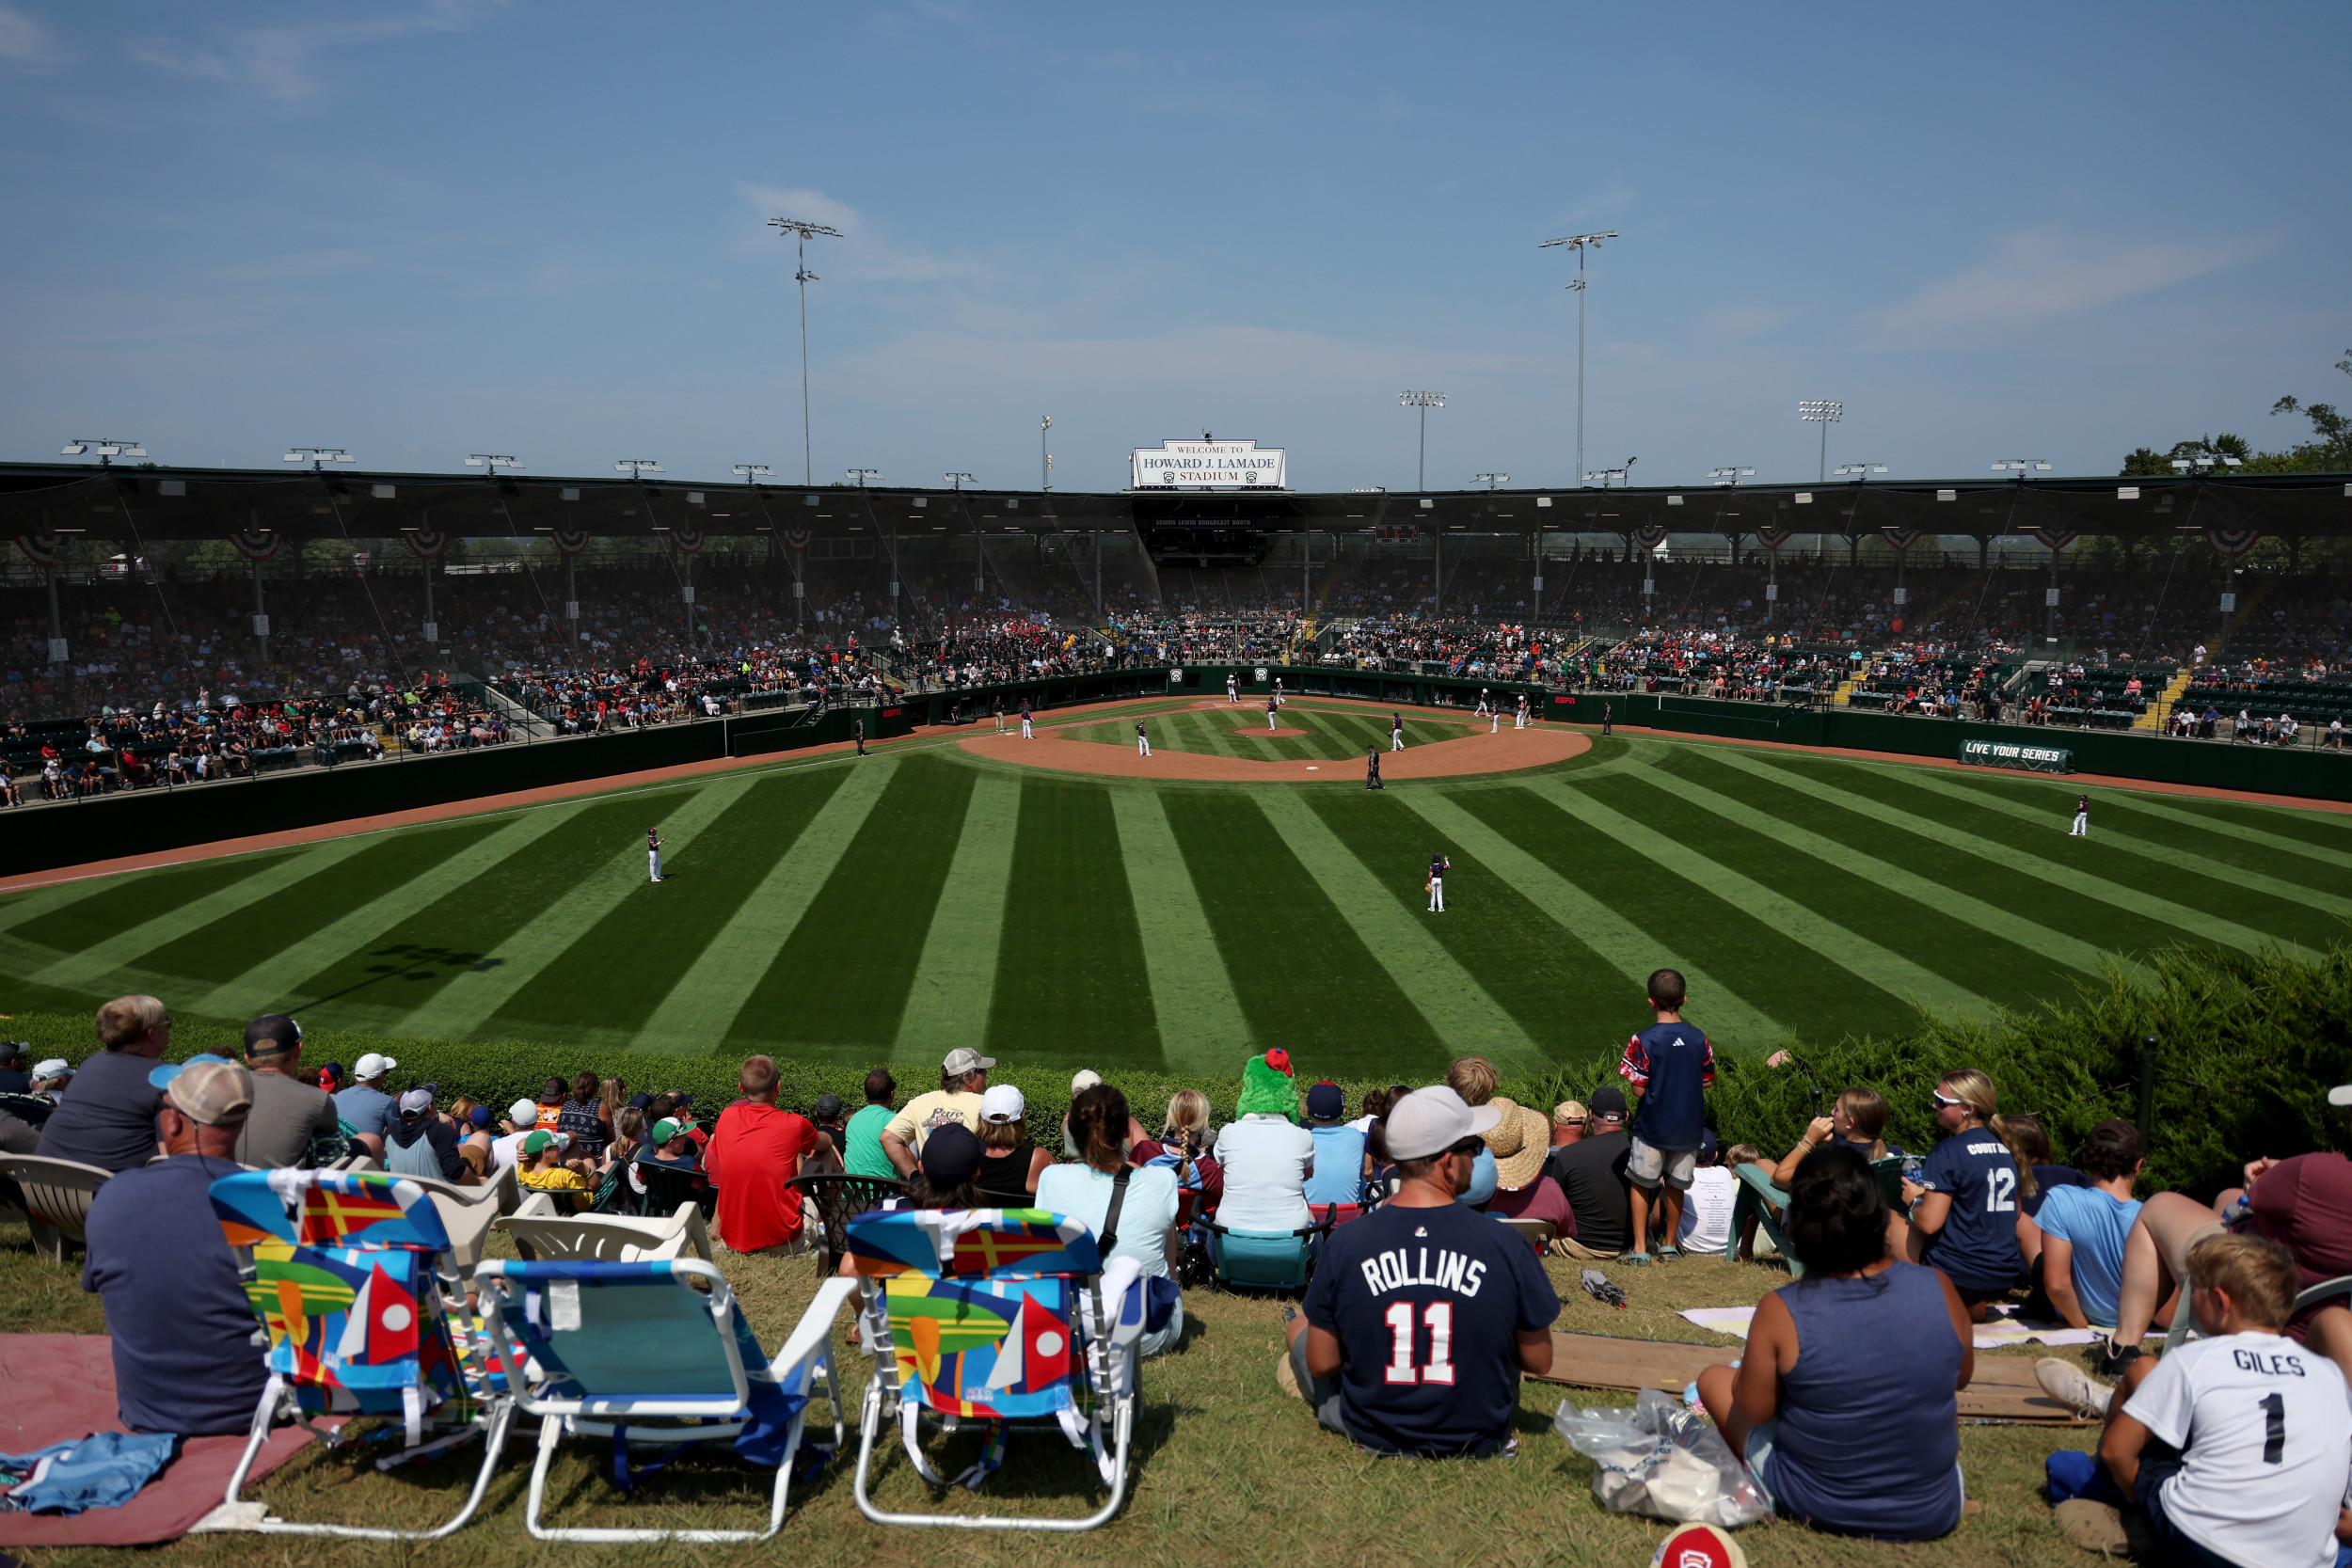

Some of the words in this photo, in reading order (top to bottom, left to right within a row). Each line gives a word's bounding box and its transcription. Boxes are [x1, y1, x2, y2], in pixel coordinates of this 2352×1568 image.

[1177, 446, 1227, 454] WELCOME
[1143, 458, 1202, 468] HOWARD
[1205, 458, 1214, 469] J.
[1218, 458, 1275, 468] LAMADE
[1180, 471, 1239, 481] STADIUM
[1554, 696, 1576, 705] ESPN
[882, 708, 901, 718] ESPN
[1966, 742, 1991, 754] LIVE
[1993, 745, 2020, 757] YOUR
[2022, 749, 2059, 761] SERIES
[1966, 1143, 1996, 1155] COURT
[1987, 1167, 2015, 1212] 12
[1360, 1246, 1487, 1297] ROLLINS
[1384, 1301, 1455, 1386] 11
[2233, 1349, 2306, 1377] GILES
[2258, 1392, 2286, 1465] 1
